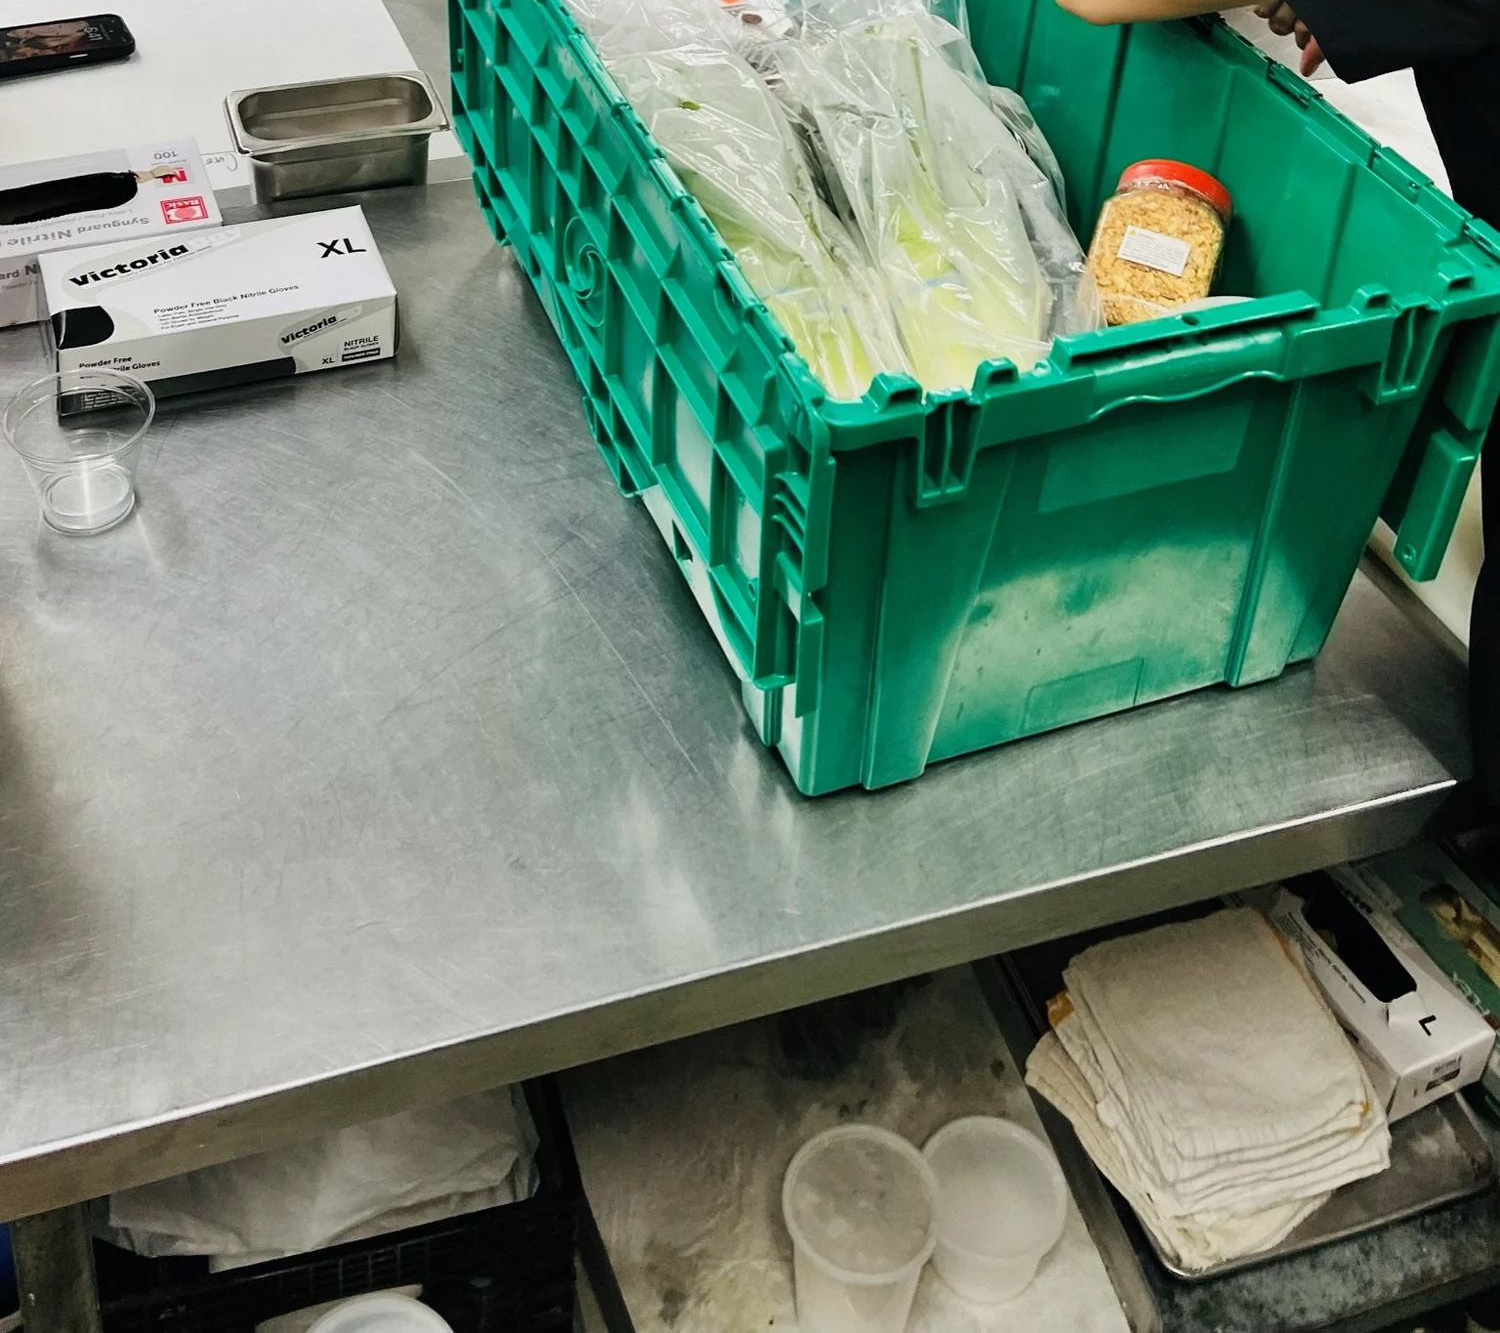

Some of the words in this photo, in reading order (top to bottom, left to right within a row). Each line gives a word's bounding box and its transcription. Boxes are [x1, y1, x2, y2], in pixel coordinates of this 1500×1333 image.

[77, 217, 149, 234] Synguard
[7, 230, 72, 246] Nitrile
[318, 238, 366, 258] XL
[68, 244, 189, 286] Victoria
[154, 304, 188, 314] Powder
[191, 299, 211, 308] Free
[213, 295, 239, 304] Black
[241, 289, 267, 300] Nitrile
[269, 284, 299, 294] Gloves
[281, 316, 337, 344] Victoria
[344, 335, 379, 347] NITRILE
[79, 360, 111, 368] Powder
[113, 356, 132, 364] Free
[132, 361, 161, 370] Gloves
[322, 357, 335, 365] XL
[1418, 1015, 1437, 1036] L
